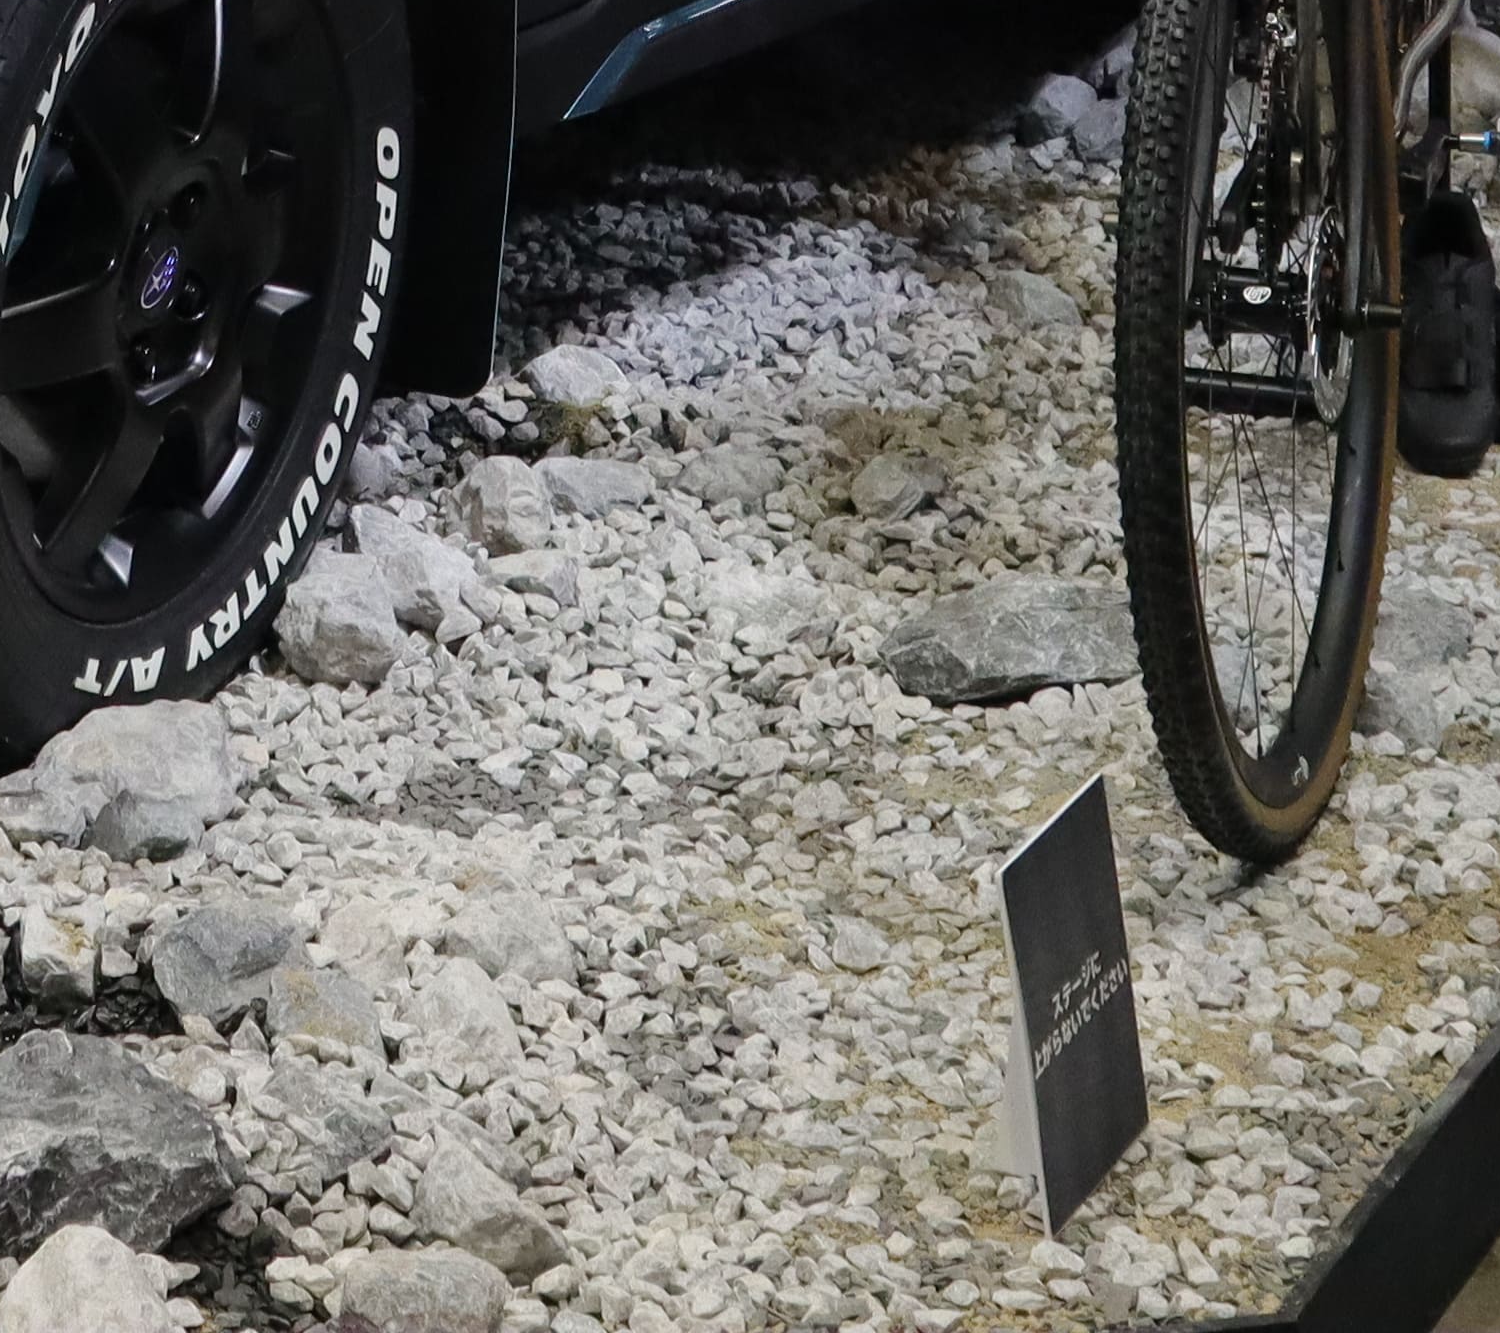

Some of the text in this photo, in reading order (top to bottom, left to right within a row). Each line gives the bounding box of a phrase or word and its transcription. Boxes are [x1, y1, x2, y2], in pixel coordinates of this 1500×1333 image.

[73, 126, 401, 697] OPEN COUNTRY A/T
[1034, 957, 1129, 1080] 上がらないでください
[1052, 950, 1102, 1021] ステージに
